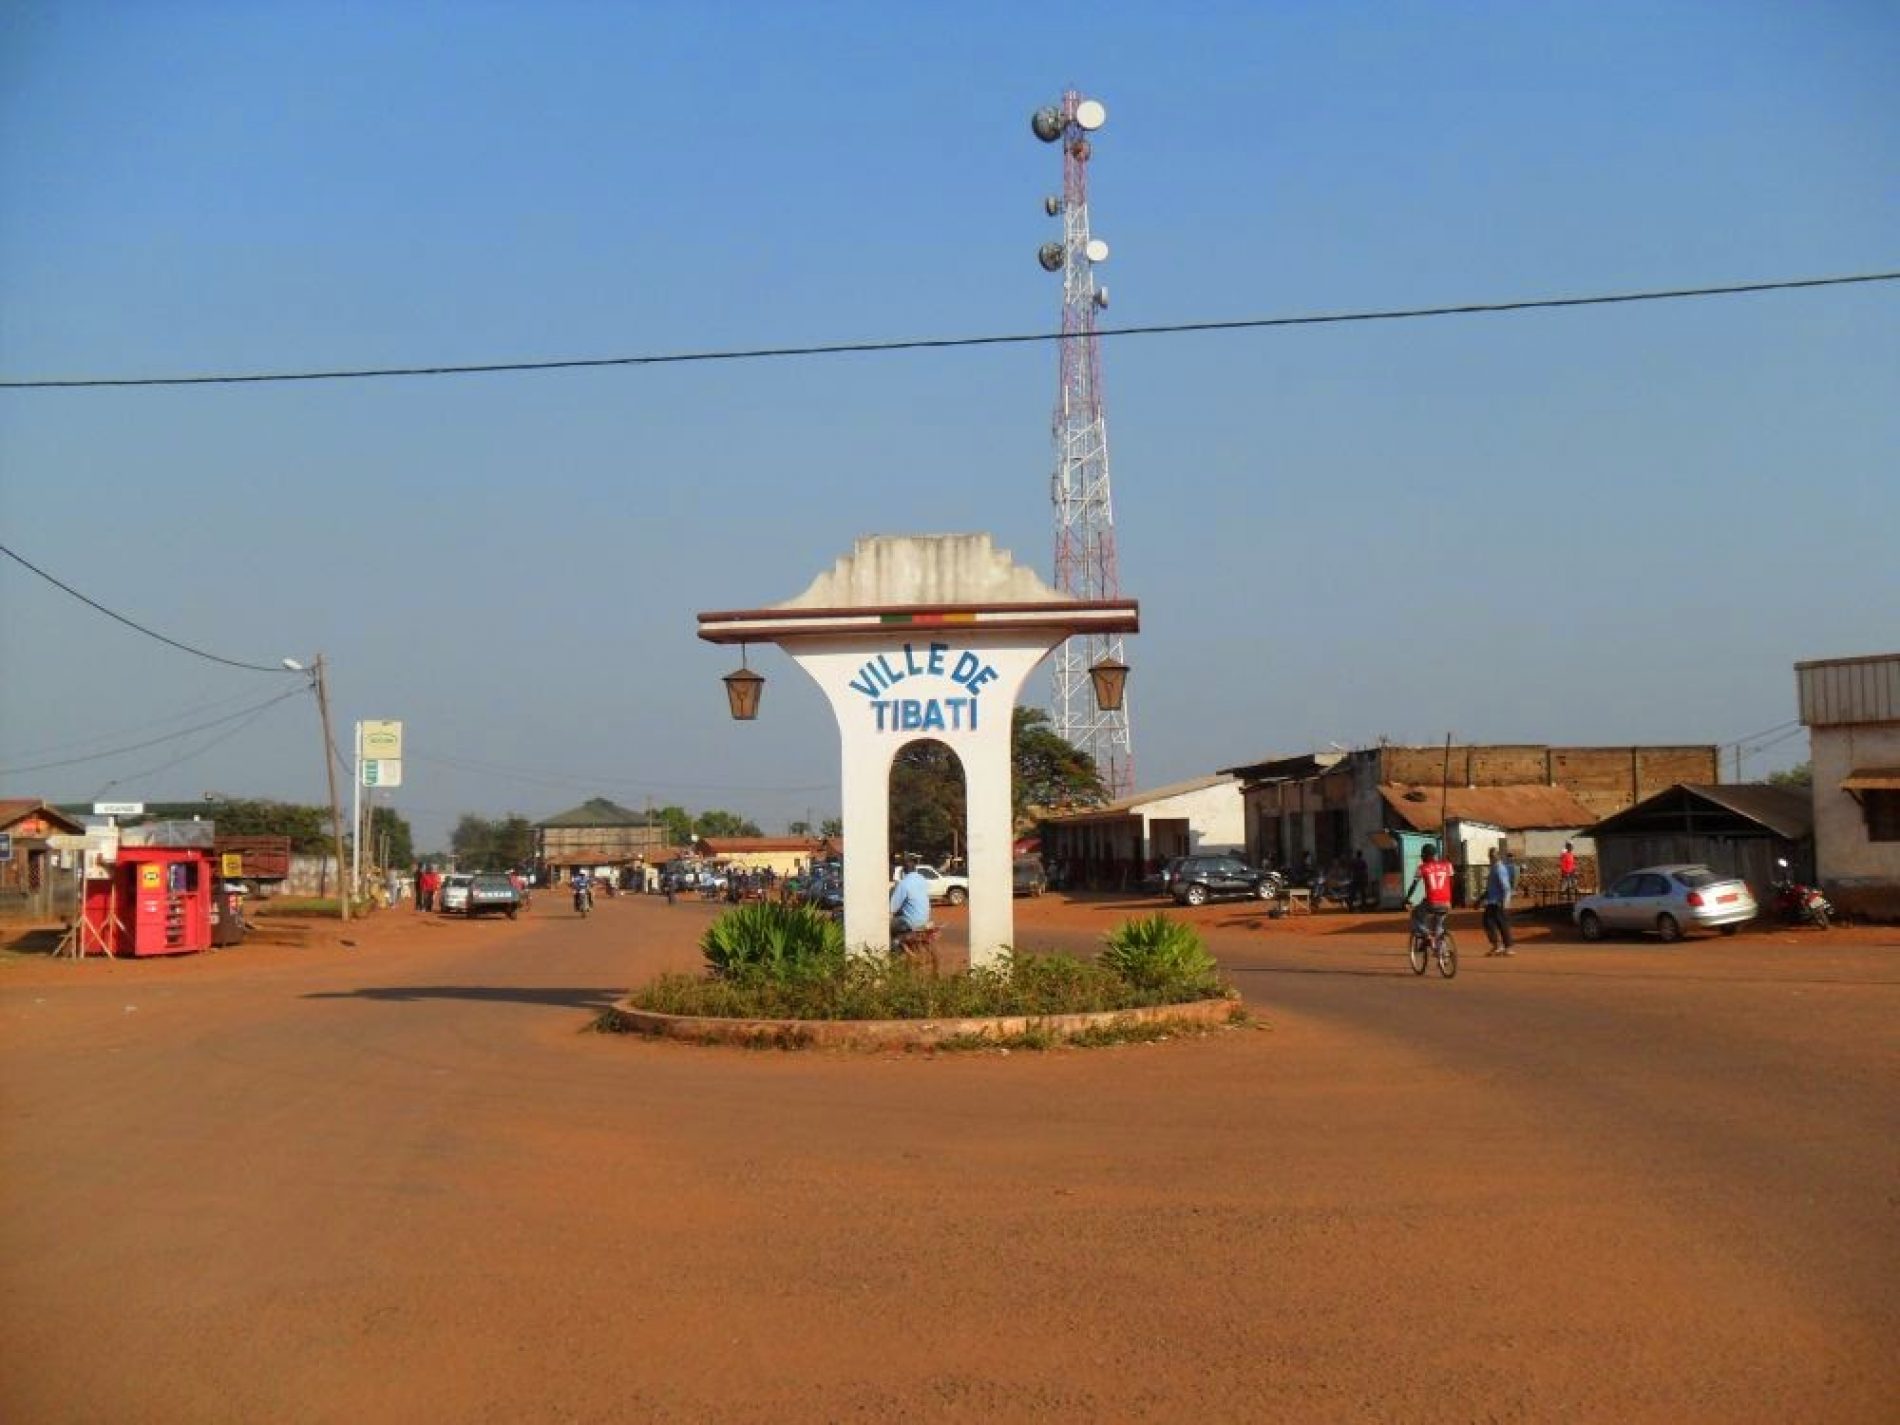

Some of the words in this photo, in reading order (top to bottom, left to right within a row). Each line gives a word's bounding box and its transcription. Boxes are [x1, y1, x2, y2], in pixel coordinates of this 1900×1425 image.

[849, 642, 949, 698] VILLE
[950, 651, 999, 696] DE
[871, 698, 978, 731] TIBATI
[1429, 871, 1446, 890] 17
